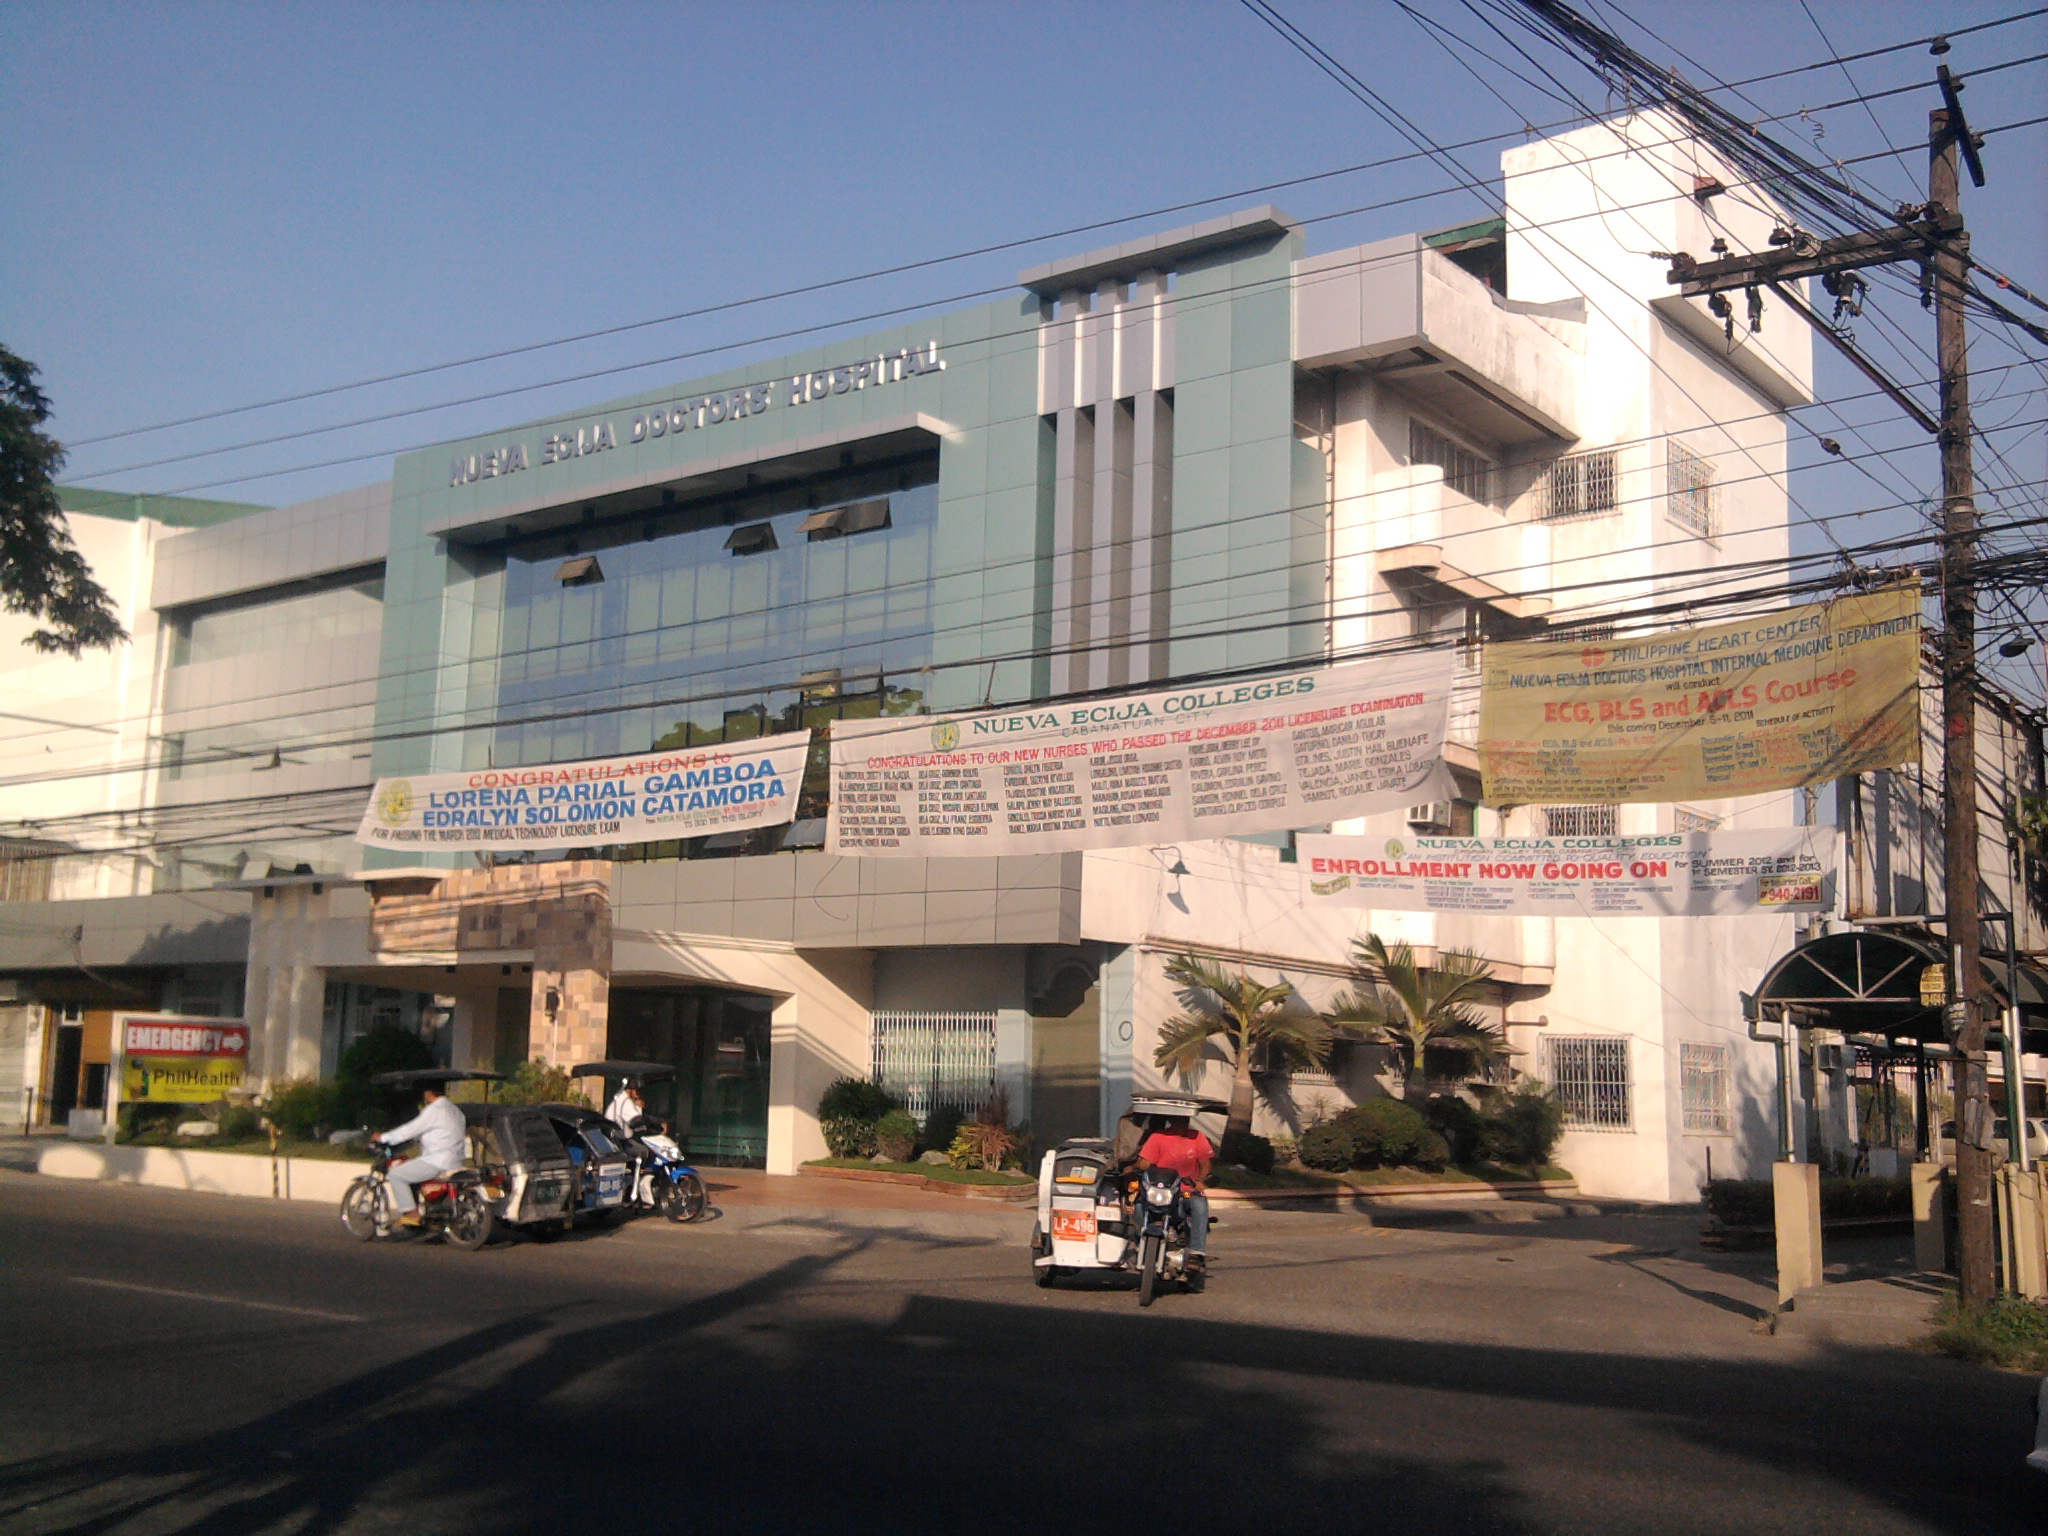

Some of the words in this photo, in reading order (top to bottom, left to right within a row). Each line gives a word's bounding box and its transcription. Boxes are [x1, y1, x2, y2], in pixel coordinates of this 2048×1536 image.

[450, 443, 530, 488] NUEVA
[541, 421, 618, 466] ECIJA
[788, 339, 947, 407] HOSPITAL
[1612, 640, 1691, 662] PHILIPPINE
[1697, 631, 1752, 652] HEART
[1755, 615, 1822, 643] CENTER
[1509, 674, 1552, 688] NUEVA
[1556, 672, 1590, 687] ECIJA
[1593, 669, 1647, 686] DOCTORS
[1650, 661, 1706, 681] HOSPITAL
[1711, 651, 1771, 673] INTERNAL
[1774, 635, 1833, 663] MEDICINE
[1837, 613, 1921, 649] DEPARTMENT
[1665, 680, 1681, 691] will
[1683, 676, 1721, 690] conduct
[973, 712, 1060, 735] NUEVA
[1070, 702, 1153, 725] ECIJA
[1163, 676, 1316, 714] COLLEGES
[1544, 701, 1594, 724] ECG,
[1599, 698, 1646, 721] BLS
[1652, 693, 1689, 718] and
[1696, 684, 1759, 713] ACLS
[1765, 669, 1857, 704] Course
[1061, 717, 1164, 738] CABANATUAN
[1175, 709, 1214, 725] CITY
[1607, 724, 1624, 734] this
[1625, 722, 1656, 734] coming
[1658, 717, 1705, 731] December
[1733, 710, 1754, 721] 2011
[1756, 715, 1790, 727] SCHEDULE
[1802, 705, 1836, 719] ACTIVITY
[867, 753, 967, 769] CONGRATULATIONS
[970, 753, 984, 765] TO
[988, 751, 1010, 764] OUR
[1014, 748, 1040, 762] NEW
[1043, 743, 1088, 759] NURSES
[1091, 739, 1117, 753] WHO
[1122, 733, 1167, 750] PASSED
[1171, 730, 1192, 743] THE
[1197, 720, 1257, 740] DECEMBER
[1261, 717, 1284, 731] 2011
[1287, 706, 1346, 727] LICENSURE
[1350, 692, 1424, 715] EXAMINATION
[1386, 733, 1430, 752] BUENAFE
[1364, 749, 1411, 767] GONZALES
[469, 753, 707, 789] CONGRATULATIONS
[713, 752, 732, 766] to
[429, 786, 531, 809] LORENA
[538, 780, 636, 804] PARIAL
[644, 759, 777, 795] GAMBOA
[423, 808, 519, 827] EDRALYN
[525, 799, 636, 825] SOLOMON
[642, 779, 785, 816] CATAMORA
[424, 828, 437, 841] THE
[483, 826, 515, 840] MEDICAL
[516, 824, 558, 840] TECHNOLOGY
[560, 821, 598, 838] LICENSURE
[600, 821, 621, 834] EXAM
[1416, 838, 1485, 849] NUEVA
[1493, 838, 1555, 849] ECIJA
[1563, 836, 1683, 849] COLLEGES
[1312, 858, 1472, 878] ENROLLMENT
[1478, 862, 1537, 879] NOW
[1542, 862, 1623, 880] GOING
[1630, 861, 1668, 879] ON
[1426, 853, 1490, 862] INSTITUTION
[1494, 853, 1561, 862] COMMITTED
[1675, 861, 1688, 869] for
[1692, 857, 1744, 868] SUMMER
[1748, 856, 1772, 866] 2012
[1776, 854, 1795, 864] and
[1799, 854, 1816, 863] for
[1704, 866, 1758, 877] SEMESTER
[1776, 861, 1821, 873] 2012-2013
[1769, 886, 1820, 901] 940-2191
[127, 1025, 224, 1052] EMERGENCY
[153, 1068, 240, 1086] PhilHealth
